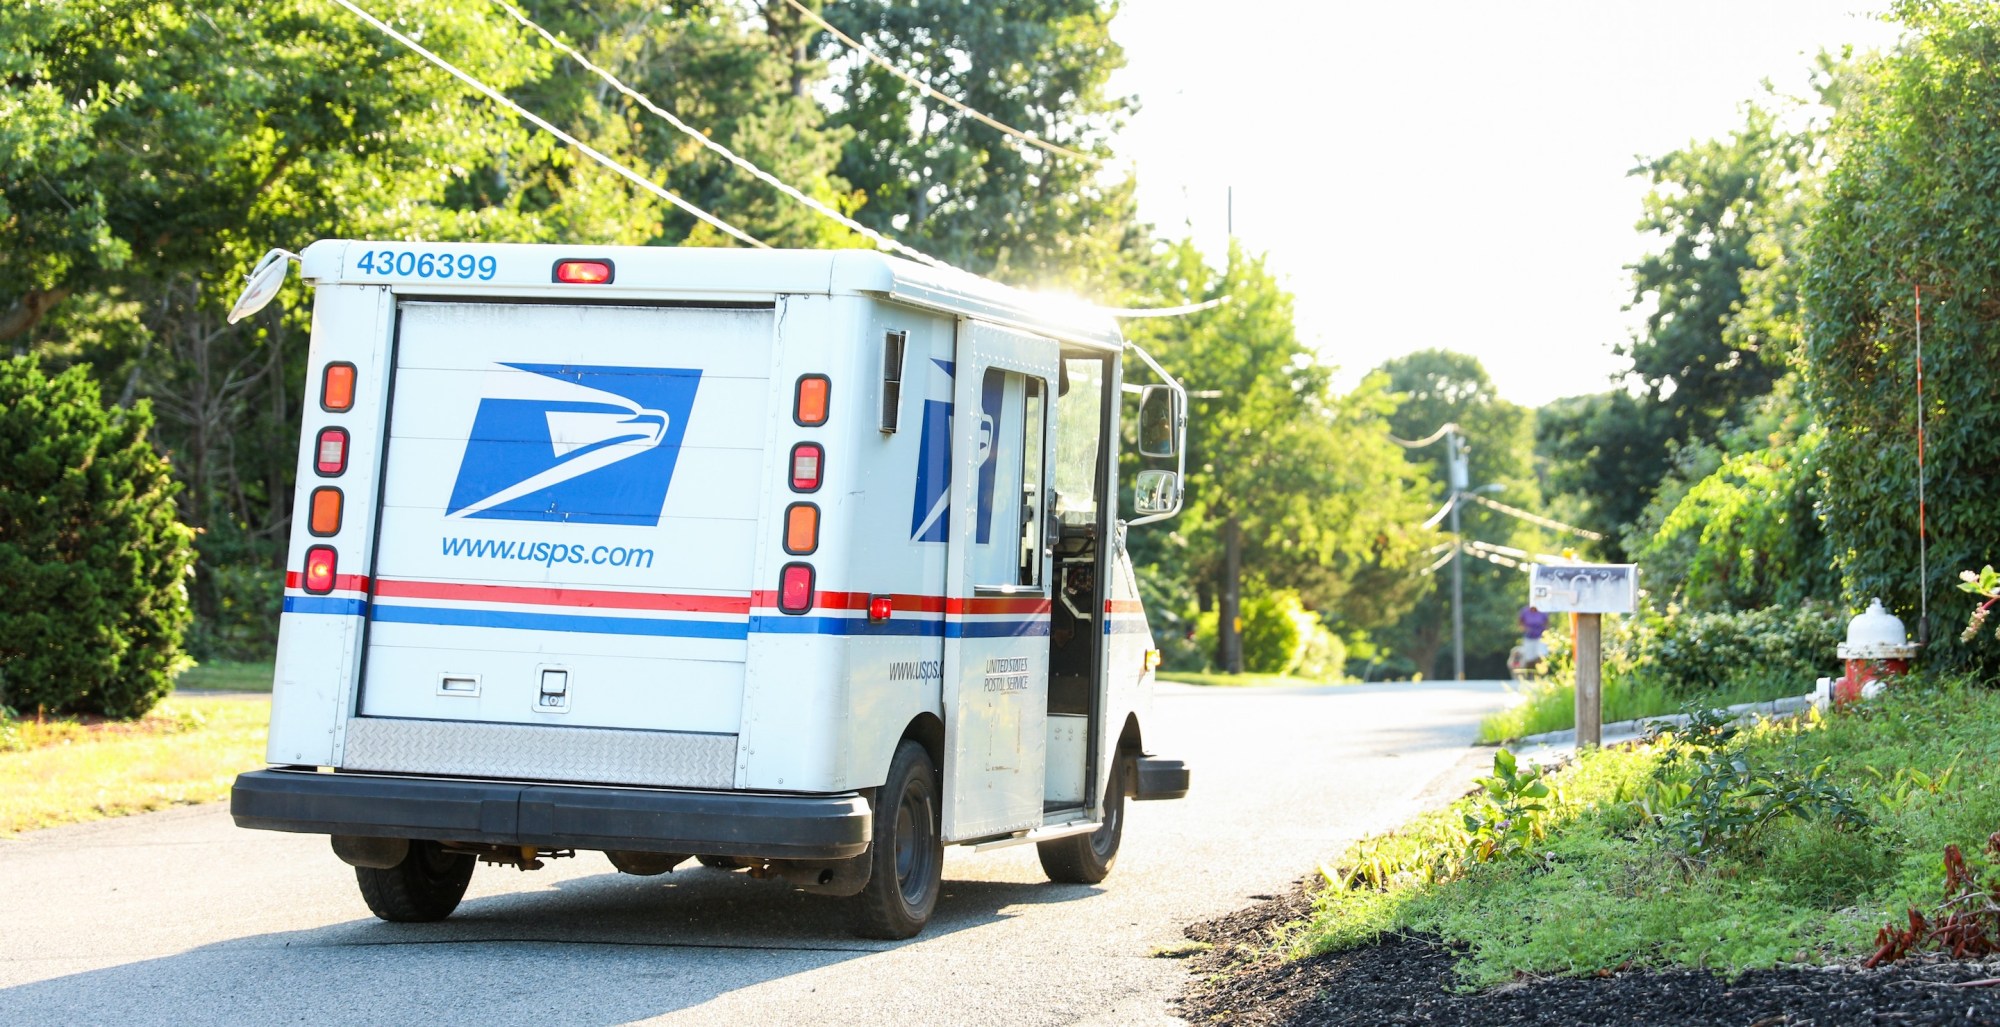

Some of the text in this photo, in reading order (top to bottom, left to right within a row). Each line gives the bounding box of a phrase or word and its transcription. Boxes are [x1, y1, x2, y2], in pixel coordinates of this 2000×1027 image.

[357, 251, 497, 280] 4306399
[442, 537, 654, 568] www.usps.com
[986, 658, 1028, 673] UNITED STATES
[984, 676, 1029, 692] POSTAL SERVICE
